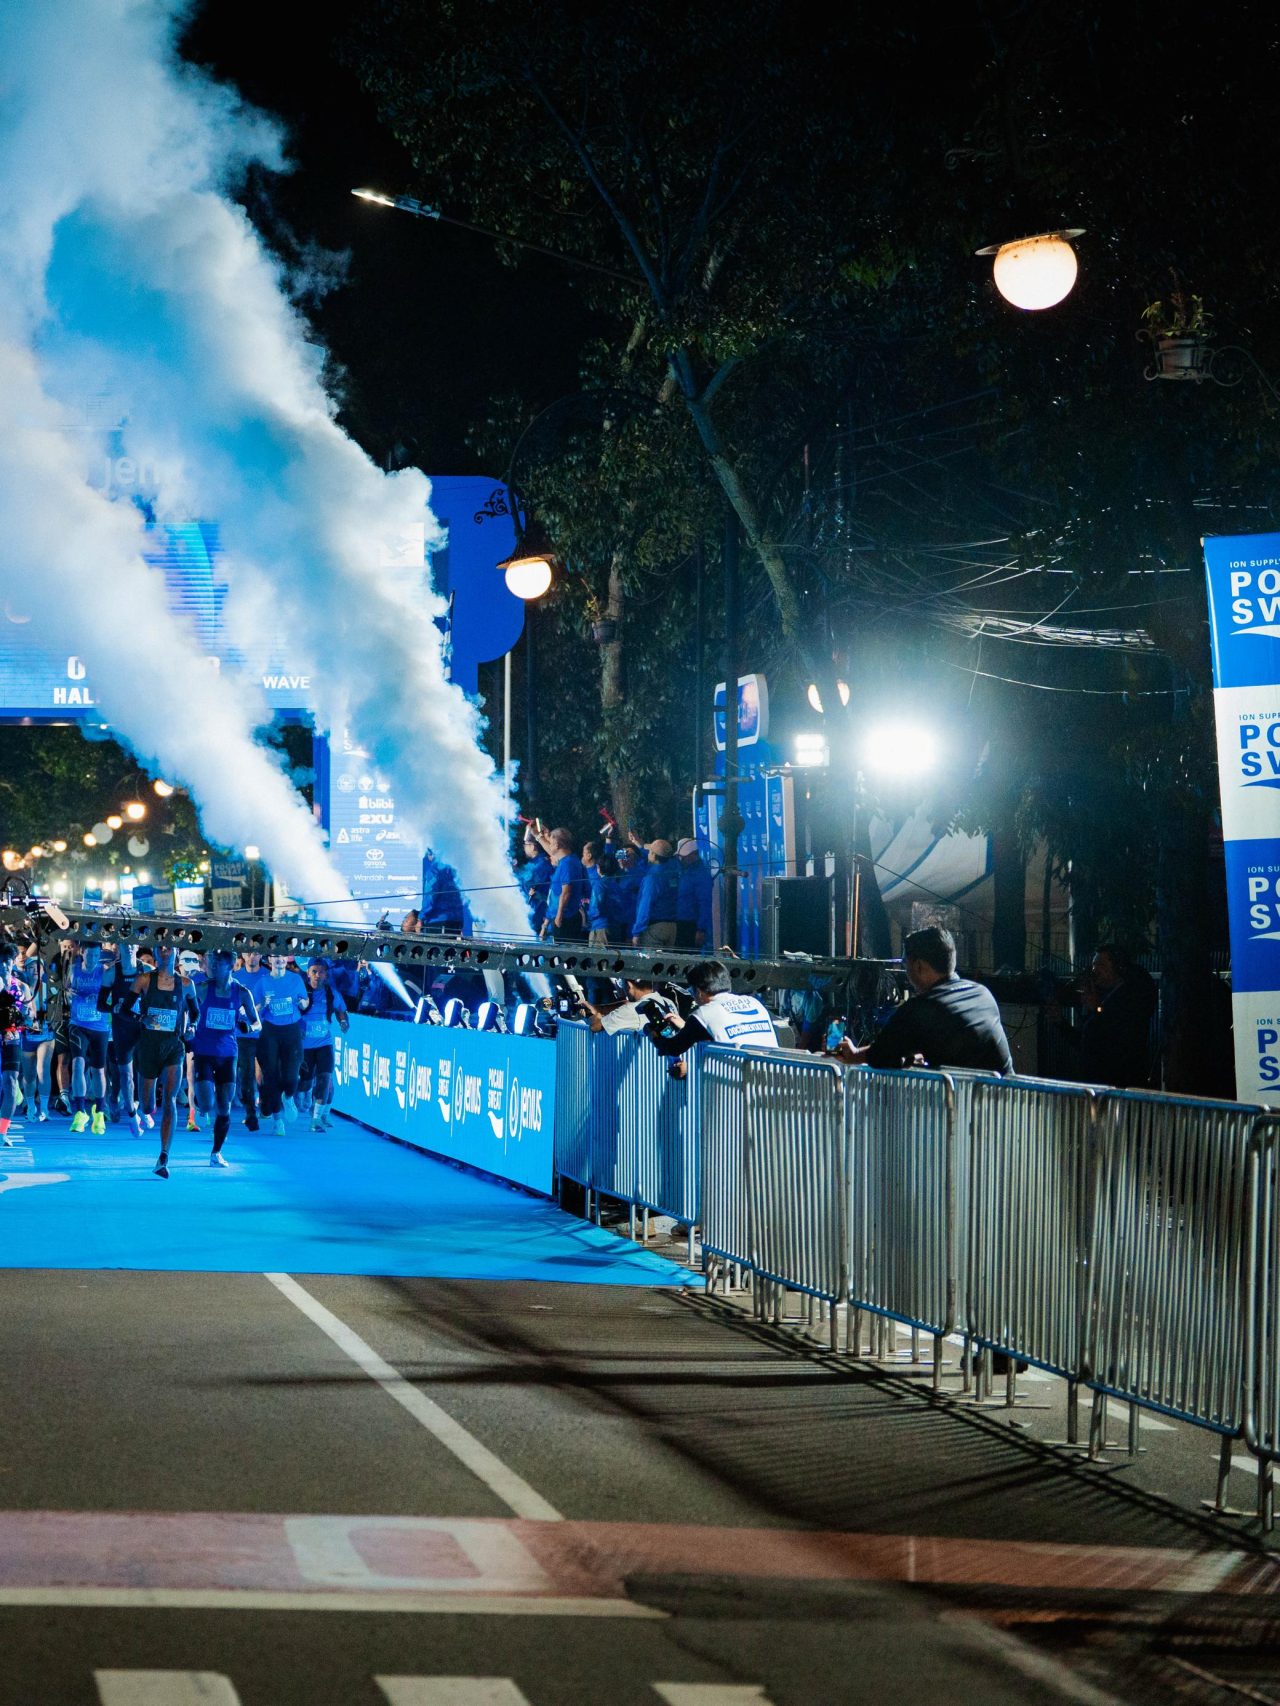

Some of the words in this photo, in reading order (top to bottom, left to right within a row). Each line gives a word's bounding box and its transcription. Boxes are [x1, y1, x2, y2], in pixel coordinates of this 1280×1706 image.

[1229, 561, 1247, 569] ION
[1250, 558, 1280, 567] SUPPL
[263, 676, 310, 689] WAVE
[53, 687, 95, 704] HAL
[359, 814, 394, 824] 2XU
[488, 1068, 504, 1090] POCARI
[487, 1088, 502, 1111] SWEAT
